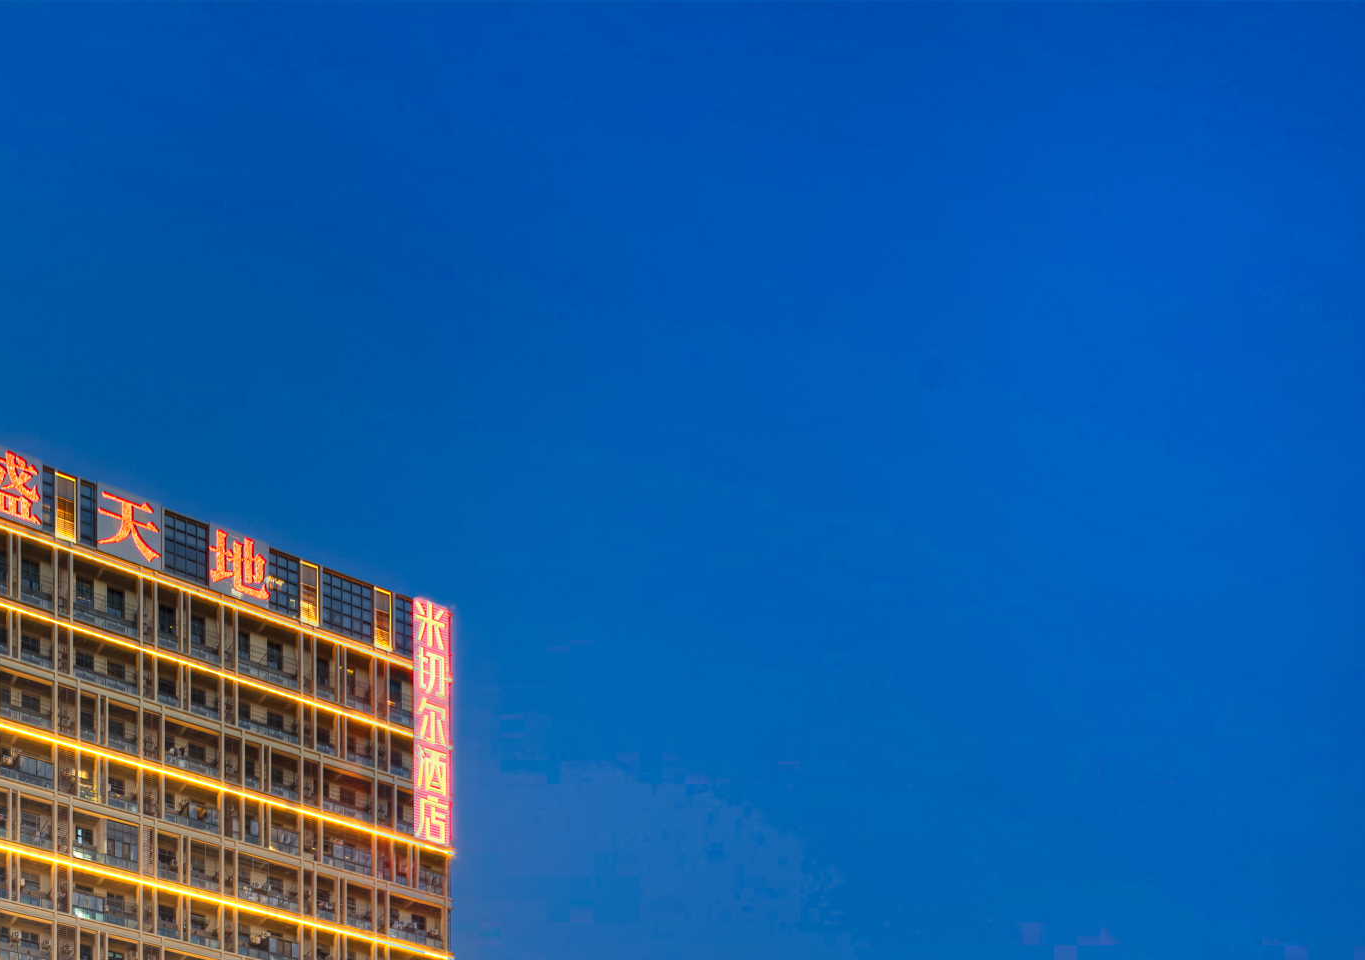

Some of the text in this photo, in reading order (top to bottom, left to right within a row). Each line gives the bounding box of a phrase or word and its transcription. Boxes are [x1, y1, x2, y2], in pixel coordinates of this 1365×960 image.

[414, 599, 448, 845] 米切尔酒店
